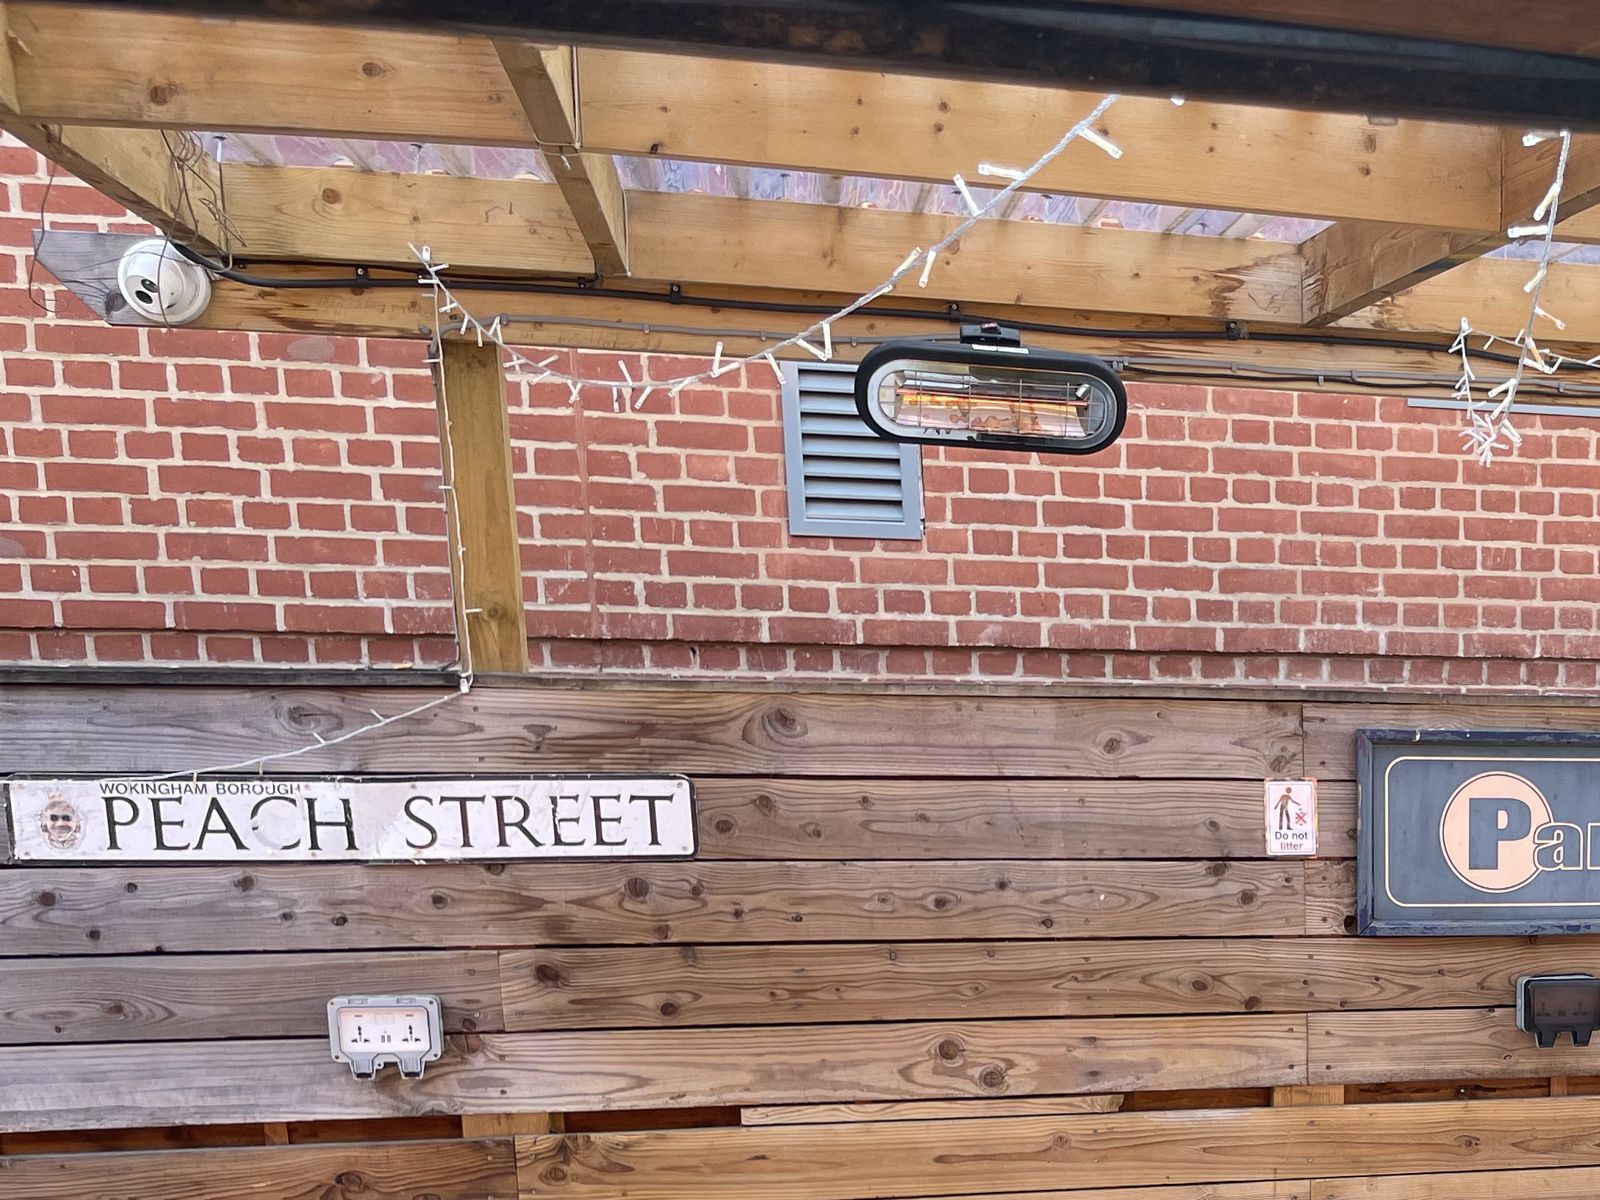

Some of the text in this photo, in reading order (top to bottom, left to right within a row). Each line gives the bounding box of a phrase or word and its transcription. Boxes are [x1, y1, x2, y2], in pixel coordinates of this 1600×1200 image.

[99, 782, 208, 796] WOKINGHAM
[101, 795, 675, 851] PEACH STREET
[1274, 831, 1309, 840] Do not
[1280, 841, 1304, 851] litter
